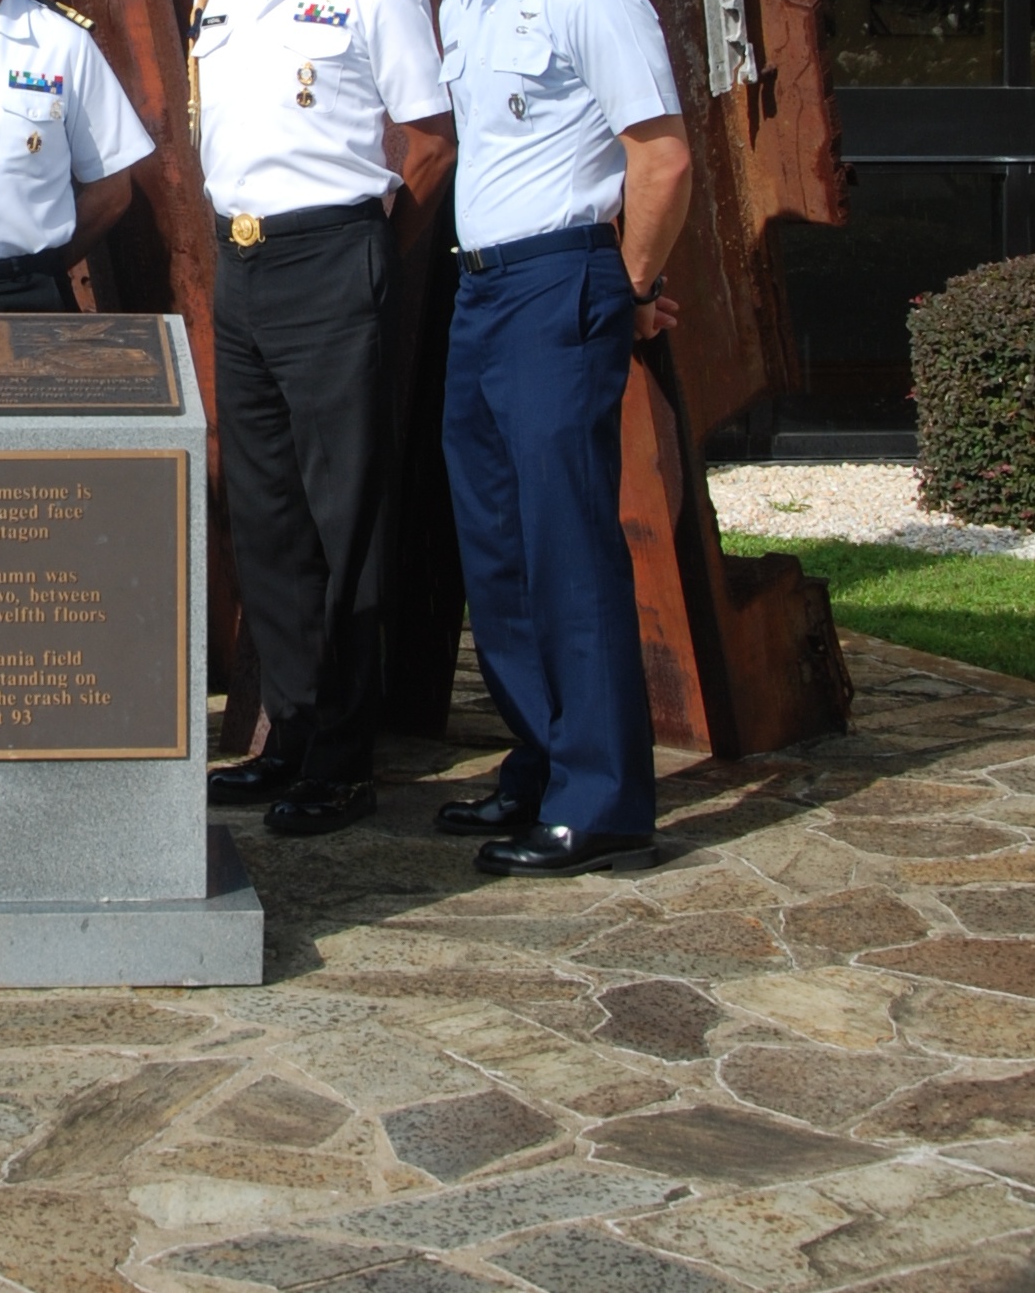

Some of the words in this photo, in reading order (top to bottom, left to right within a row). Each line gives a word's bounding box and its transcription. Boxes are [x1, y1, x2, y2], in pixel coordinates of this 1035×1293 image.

[77, 483, 92, 500] is
[48, 503, 83, 520] face
[45, 570, 77, 584] was
[30, 588, 101, 603] between
[54, 607, 106, 623] floors
[43, 650, 82, 667] field
[75, 673, 97, 687] on
[24, 691, 71, 706] crash
[80, 690, 111, 706] site
[11, 710, 33, 725] 93
